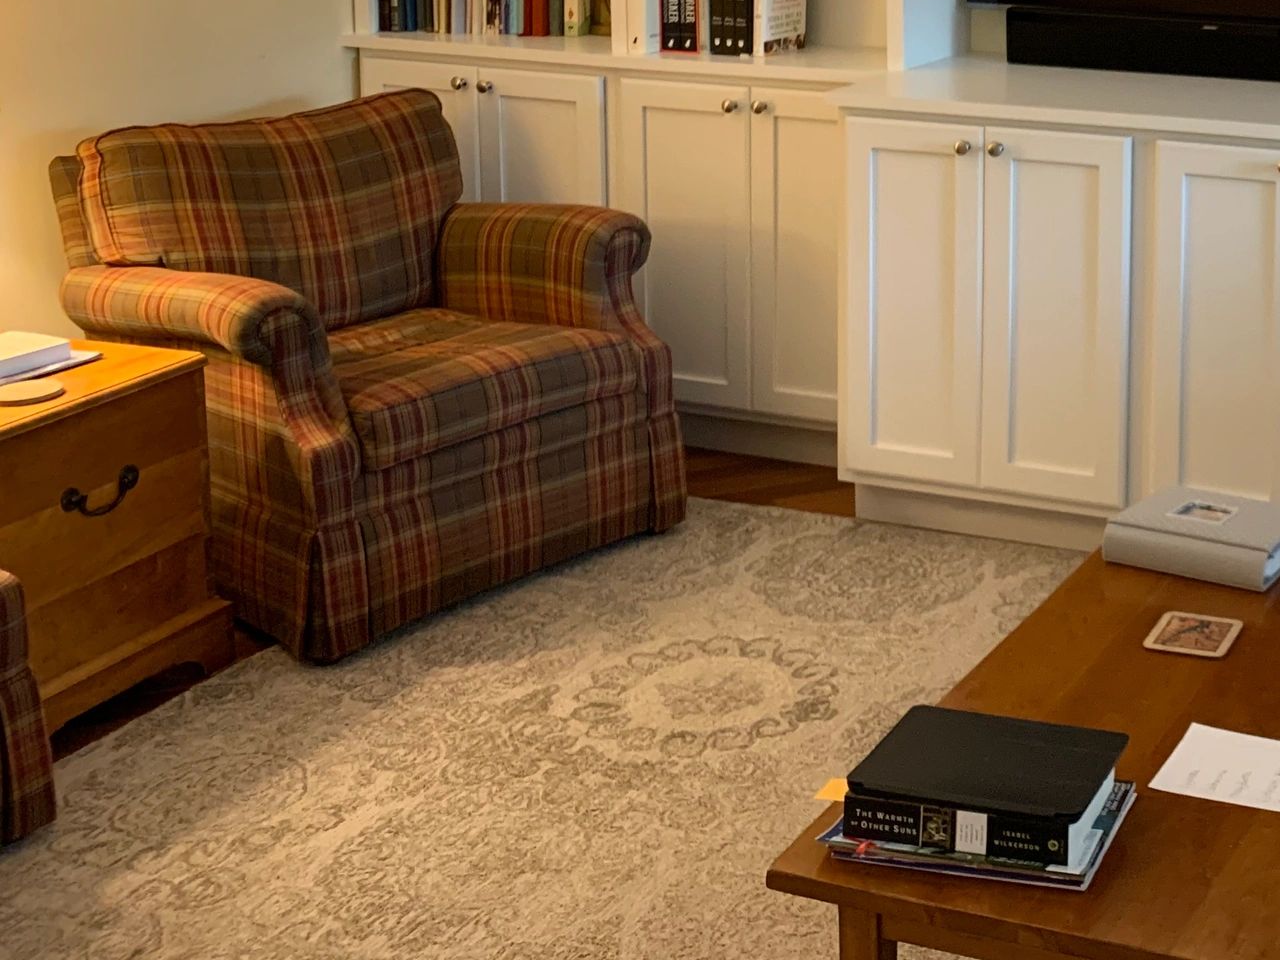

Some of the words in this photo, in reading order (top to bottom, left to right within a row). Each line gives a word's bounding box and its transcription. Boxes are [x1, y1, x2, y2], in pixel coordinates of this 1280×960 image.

[856, 808, 872, 818] THE
[876, 811, 914, 824] WARMTH
[860, 821, 889, 831] OTHER
[893, 824, 917, 835] SUNS
[1002, 830, 1031, 839] ISABEL
[994, 840, 1040, 851] WILKERSON
